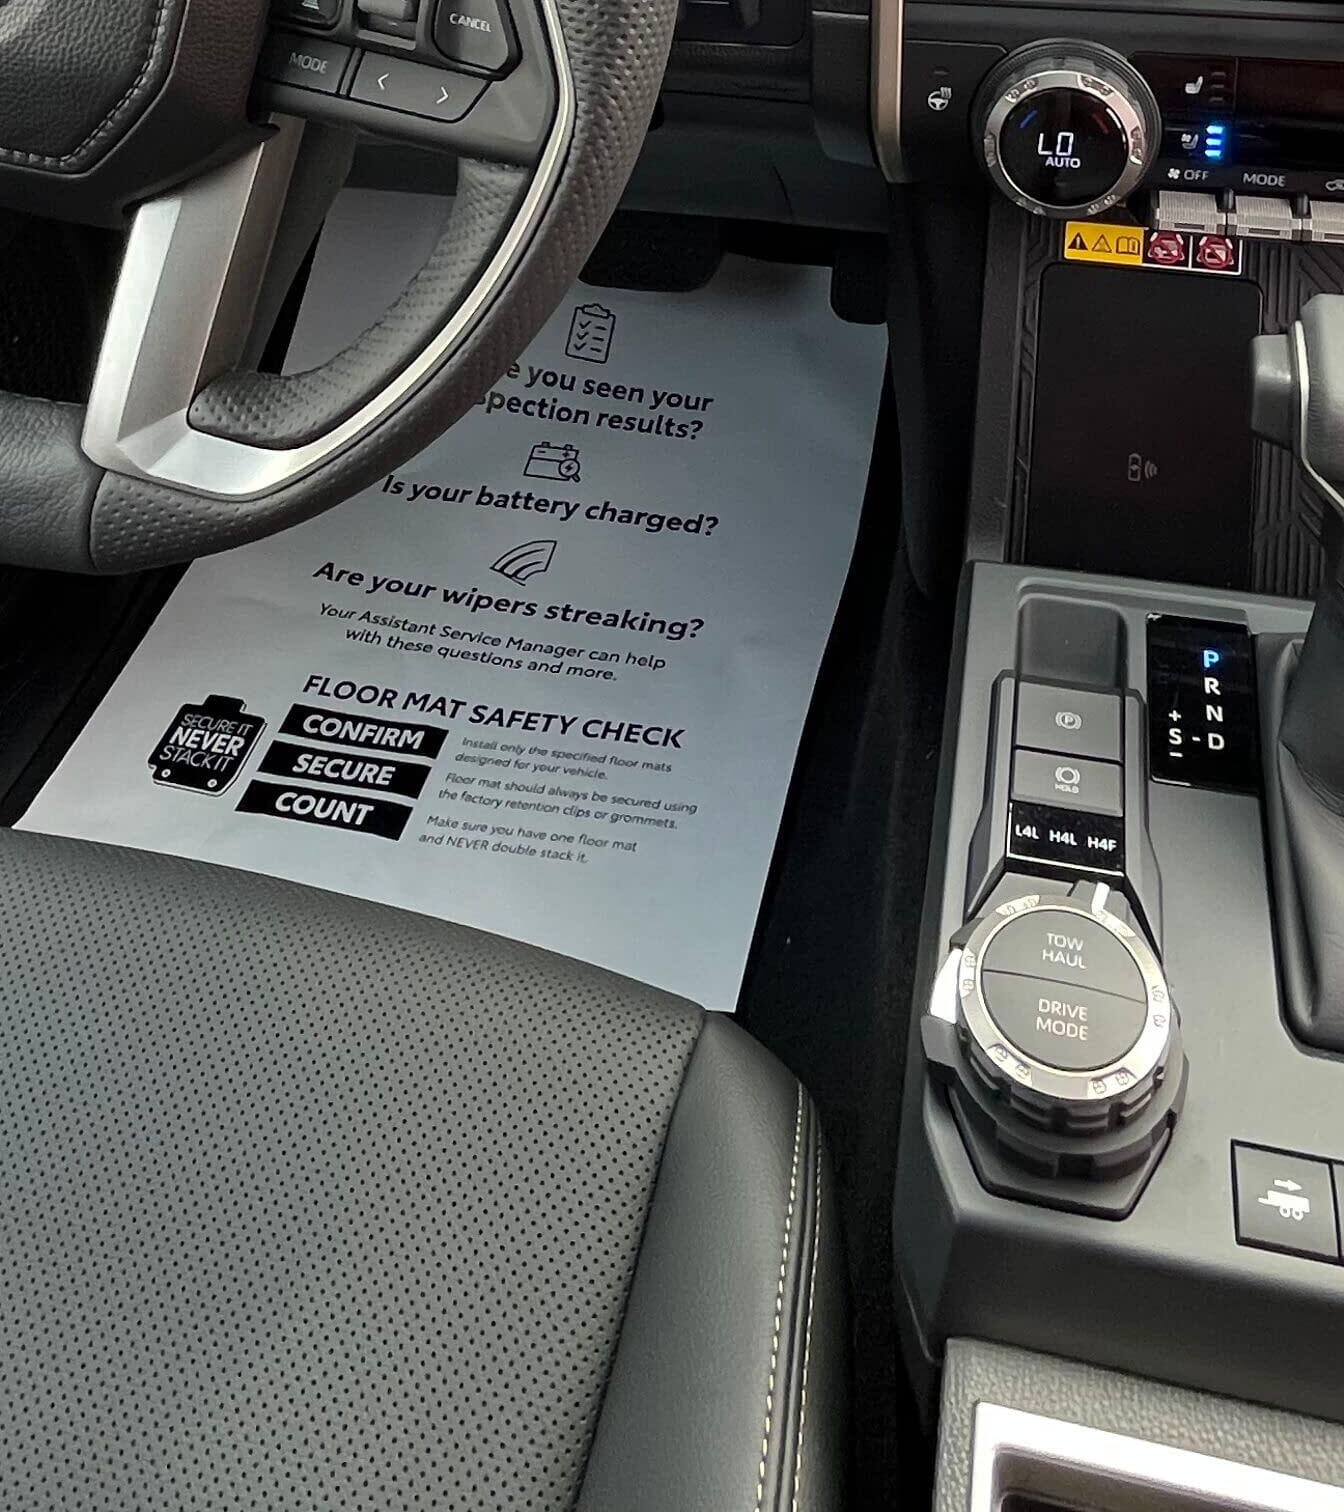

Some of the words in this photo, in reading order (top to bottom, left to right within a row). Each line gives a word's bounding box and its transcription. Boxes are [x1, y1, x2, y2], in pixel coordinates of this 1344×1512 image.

[449, 13, 492, 33] CANCEL
[288, 51, 328, 74] MODE
[1037, 131, 1074, 157] LO
[1044, 156, 1081, 169] AUTO
[1184, 168, 1209, 181] OFF
[1242, 172, 1286, 188] MODE
[526, 364, 577, 391] you
[582, 377, 644, 404] seen
[648, 388, 714, 412] your
[595, 411, 704, 440] results?
[382, 475, 404, 495] Is
[406, 482, 473, 504] your
[475, 485, 580, 523] battery
[585, 501, 720, 537] charged?
[312, 561, 365, 586] Are
[366, 574, 437, 599] your
[442, 587, 538, 619] wipers
[544, 603, 705, 642] streaking?
[319, 603, 358, 621] Your
[358, 609, 438, 637] Assistant
[439, 625, 502, 648] Service
[505, 636, 587, 661] Manager
[588, 648, 621, 664] can
[625, 651, 667, 671] help
[344, 626, 383, 646] with
[386, 635, 433, 654] these
[437, 645, 523, 671] questions
[527, 658, 563, 675] and
[566, 664, 617, 682] more.
[1203, 649, 1220, 668] P
[1204, 677, 1221, 696] R
[180, 713, 235, 735] SECURE
[237, 722, 254, 736] IT
[302, 674, 398, 710] FLOOR
[401, 692, 467, 720] MAT
[468, 704, 579, 736] SAFETY
[581, 719, 686, 749] CHECK
[1206, 705, 1223, 722] N
[168, 726, 246, 757] NEVER
[302, 714, 425, 751] CONFIRM
[1169, 728, 1183, 745] S
[1207, 733, 1225, 750] D
[159, 745, 216, 769] STACK
[215, 756, 235, 773] IT
[292, 753, 396, 786] SECURE
[455, 752, 511, 768] designed
[513, 759, 531, 770] for
[532, 763, 560, 775] your
[563, 766, 608, 780] vehicle.
[461, 737, 498, 752] Install
[499, 743, 526, 755] only
[528, 746, 548, 757] the
[551, 750, 607, 765] specified
[609, 756, 640, 768] floor
[641, 761, 672, 774] mats
[445, 772, 476, 785] Floor
[478, 777, 502, 789] mat
[504, 781, 546, 795] should
[547, 786, 588, 801] always
[591, 791, 608, 803] be
[610, 794, 661, 810] secured
[663, 801, 698, 816] using
[1055, 784, 1079, 794] HOLD
[274, 792, 374, 826] COUNT
[438, 789, 458, 800] the
[460, 791, 503, 809] factory
[505, 799, 560, 814] retention
[562, 804, 592, 819] clips
[610, 812, 678, 831] grommets.
[418, 833, 445, 846] and
[445, 835, 490, 852] NEVER
[491, 841, 538, 856] double
[540, 848, 574, 862] stack
[426, 815, 459, 829] Make
[461, 820, 488, 833] sure
[489, 823, 514, 837] you
[517, 827, 547, 841] have
[550, 831, 575, 844] one
[578, 834, 609, 848] floor
[611, 840, 638, 853] mat
[1015, 824, 1040, 840] L4L
[1049, 829, 1078, 846] H4L
[1087, 836, 1117, 852] H4F
[1046, 932, 1085, 951] TOW
[1042, 948, 1088, 970] HAUL
[1038, 998, 1088, 1022] DRIVE
[1035, 1016, 1089, 1041] MODE
